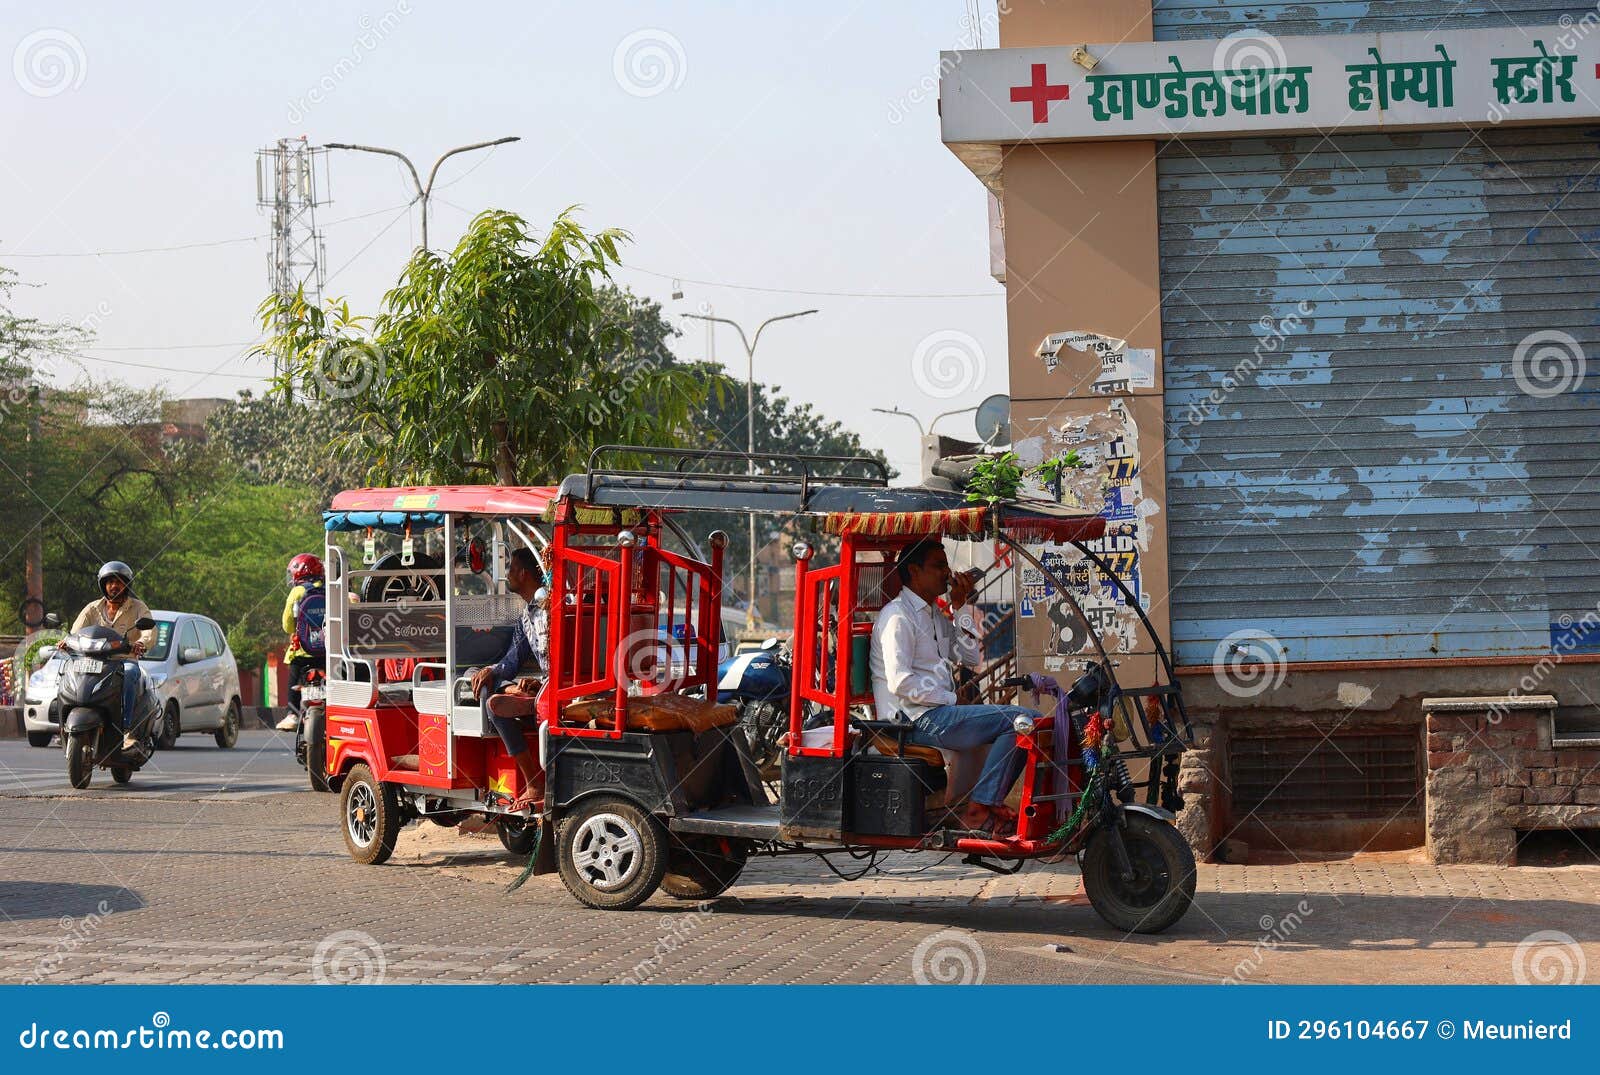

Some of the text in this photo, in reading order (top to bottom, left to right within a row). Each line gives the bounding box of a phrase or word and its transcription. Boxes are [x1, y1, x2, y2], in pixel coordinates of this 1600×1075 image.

[1345, 44, 1457, 111] होम्यो
[1491, 39, 1578, 104] स्टोर
[1024, 585, 1046, 598] FREE
